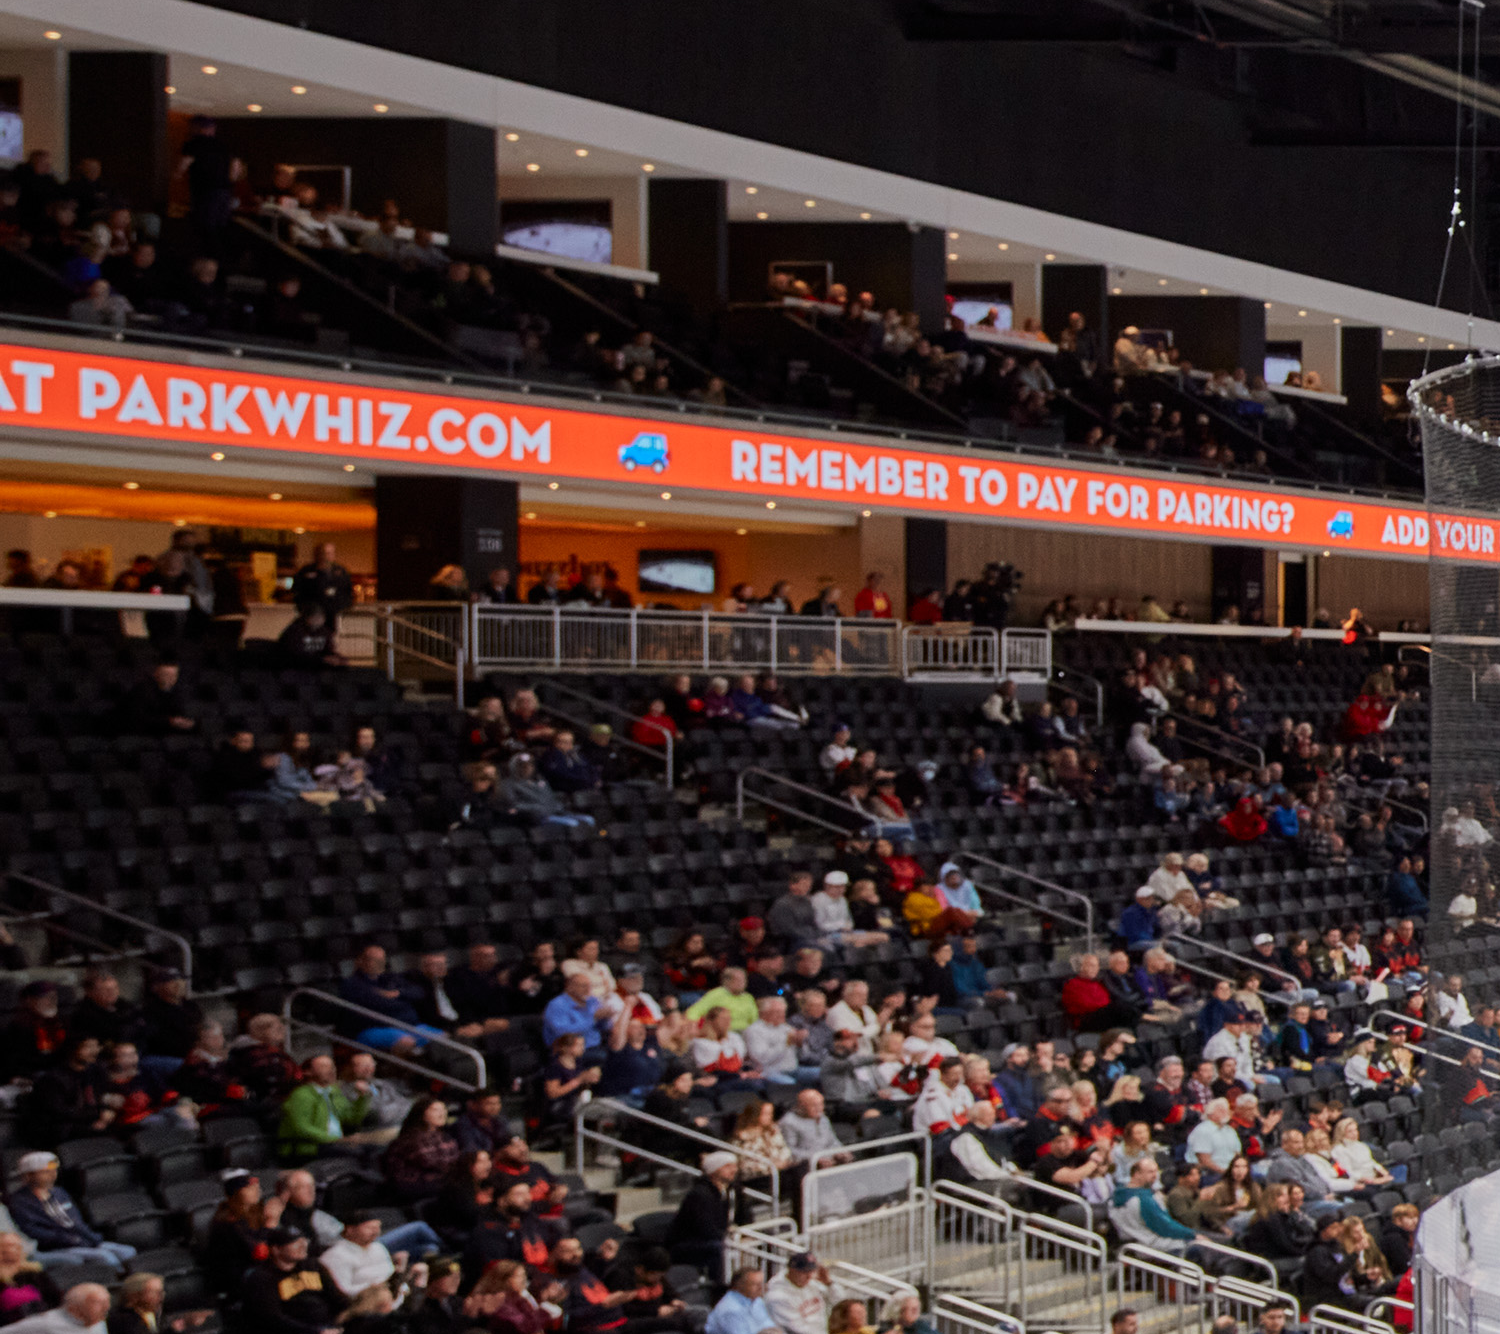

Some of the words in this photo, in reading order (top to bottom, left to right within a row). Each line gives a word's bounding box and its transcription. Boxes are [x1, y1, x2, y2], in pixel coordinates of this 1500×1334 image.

[79, 368, 551, 463] PARKWHIZ.COM
[732, 440, 948, 500] REMEMBER
[959, 466, 1008, 505] TO
[1018, 473, 1078, 512] PAY
[1088, 481, 1150, 519] FOR
[1158, 489, 1295, 533] PARKING?
[1382, 516, 1430, 546] ADD
[1435, 520, 1495, 553] YOUR
